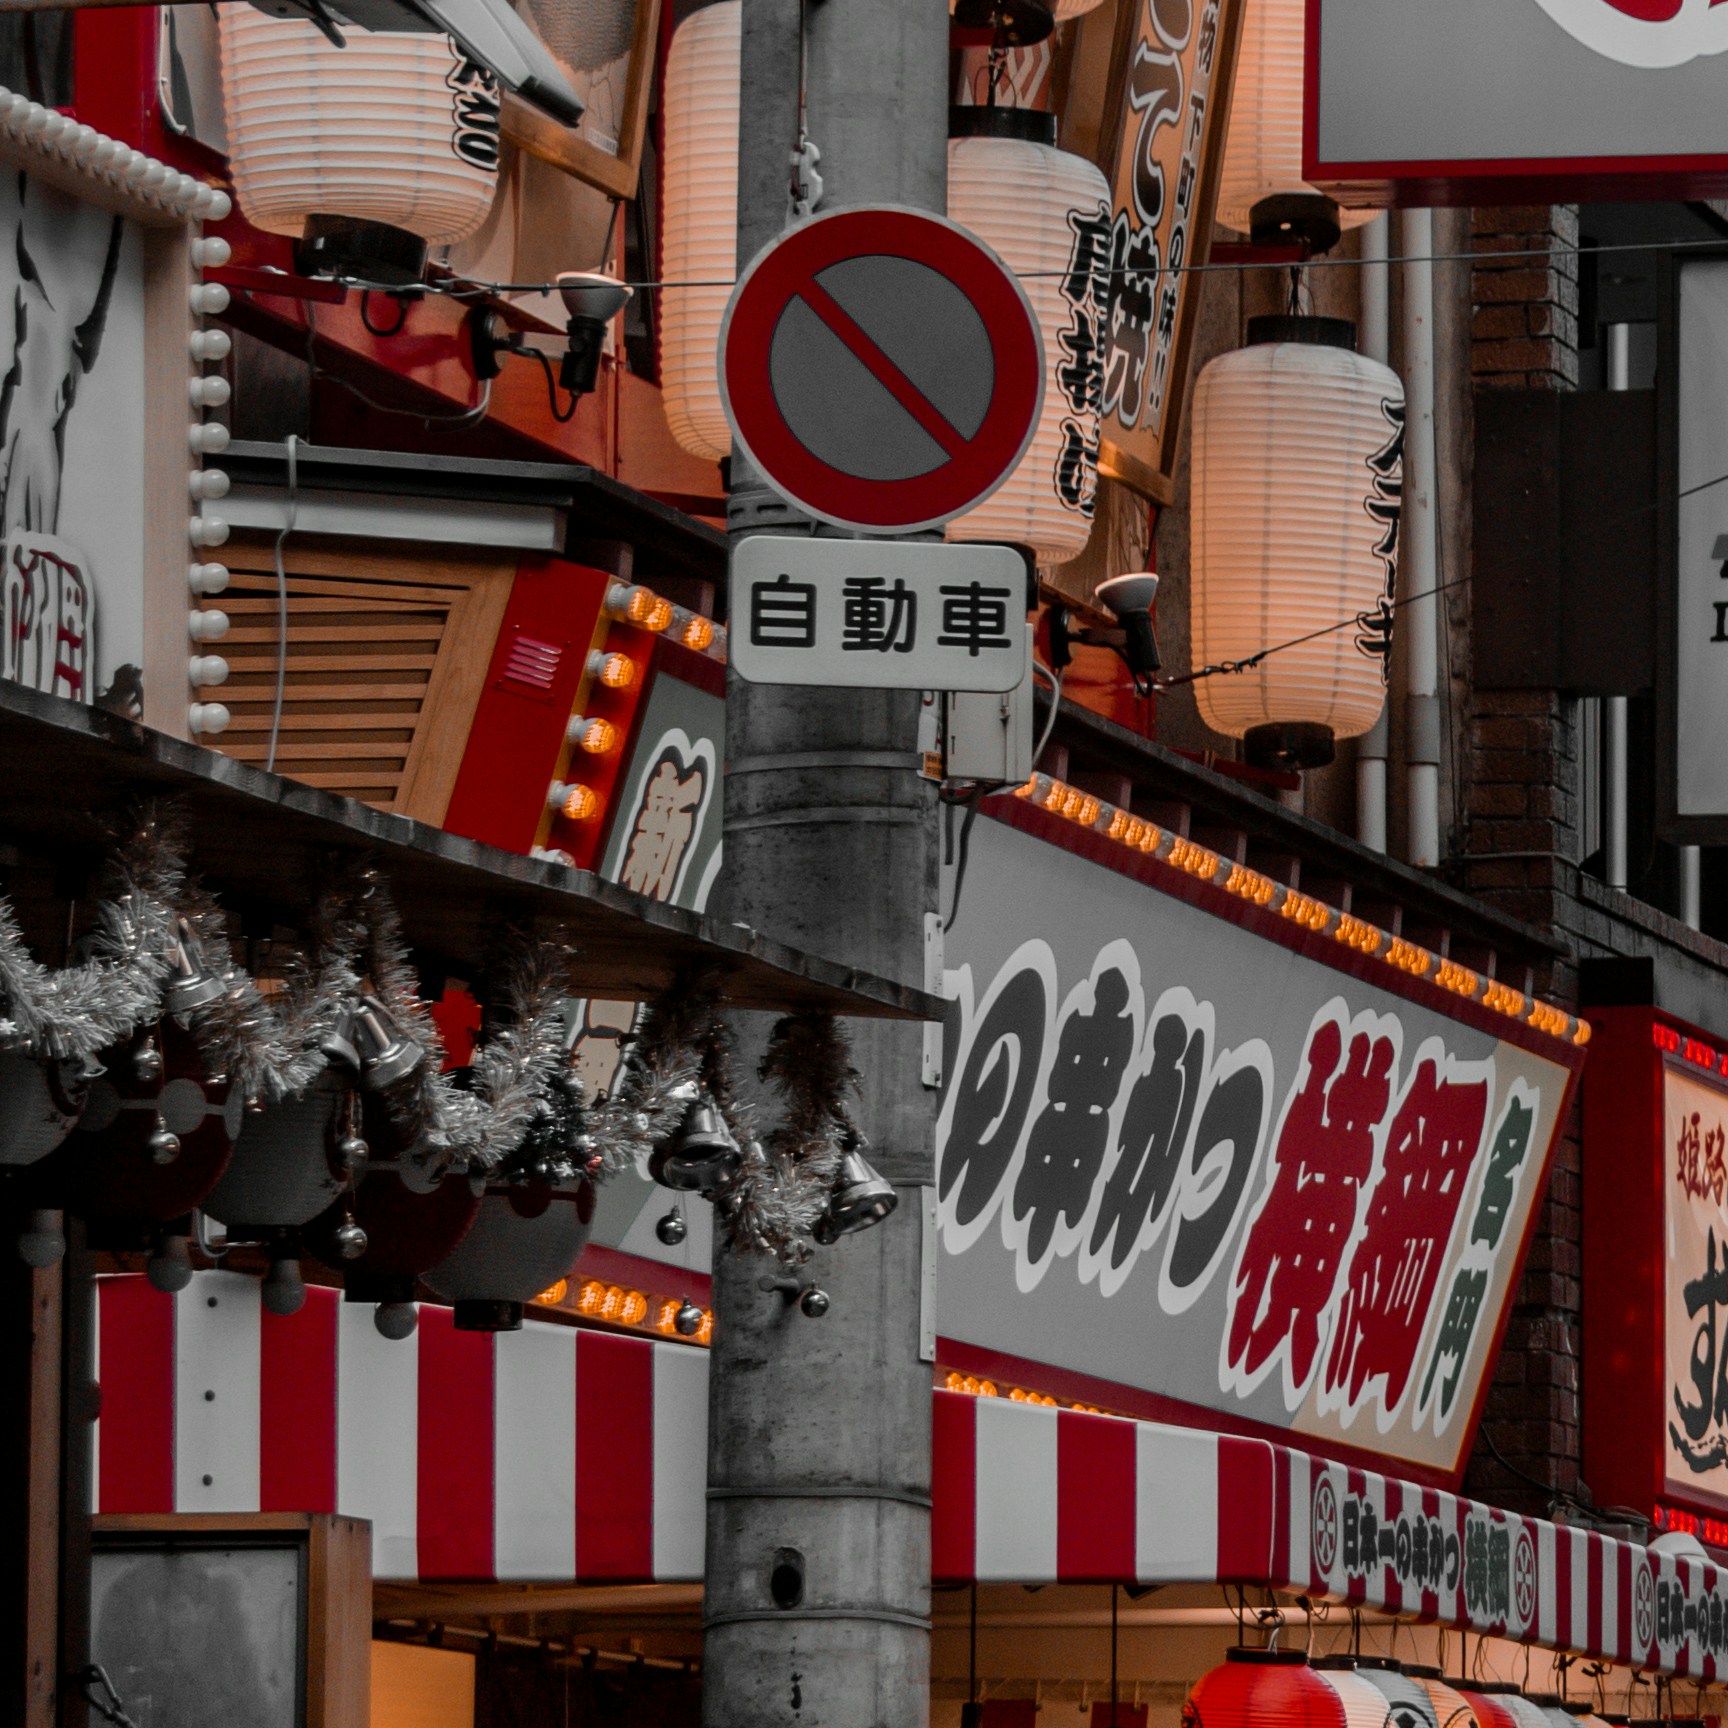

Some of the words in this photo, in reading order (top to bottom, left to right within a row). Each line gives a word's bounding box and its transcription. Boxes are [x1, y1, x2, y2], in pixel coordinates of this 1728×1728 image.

[749, 572, 1012, 657] 自動車
[1343, 1500, 1460, 1592] 日本一の串かつ
